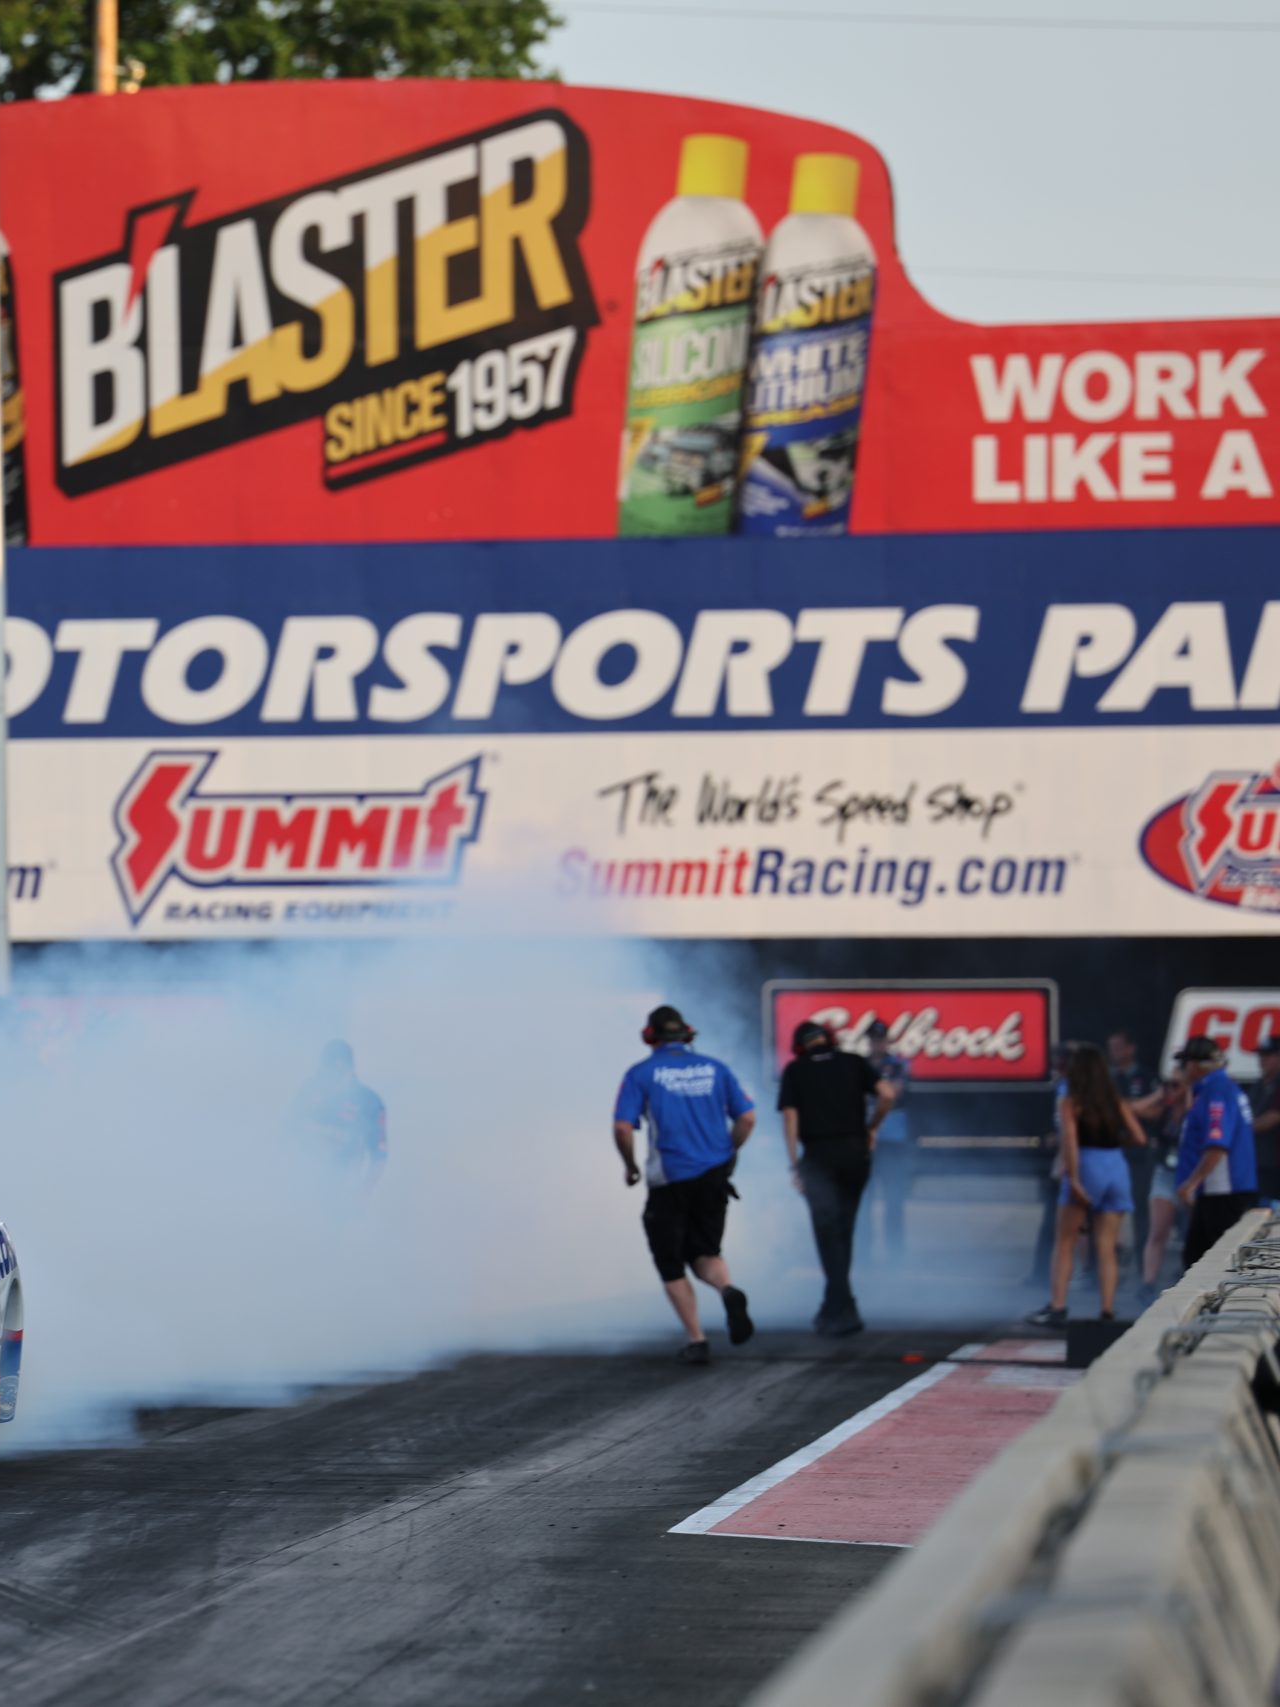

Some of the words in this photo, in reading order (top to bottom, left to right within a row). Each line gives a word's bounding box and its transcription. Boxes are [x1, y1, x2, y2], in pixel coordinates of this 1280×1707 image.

[324, 371, 448, 463] SINCE
[447, 326, 577, 438] 1957
[970, 349, 1267, 424] WORK
[972, 432, 1176, 503] LIKE
[1199, 430, 1274, 499] A
[1019, 601, 1280, 713] PA
[127, 763, 467, 896] SUMMIT
[597, 770, 680, 836] The
[696, 773, 802, 828] World's
[813, 780, 916, 844] Speed
[926, 784, 1015, 839] Shop
[164, 902, 273, 921] RACING
[557, 847, 1069, 907] SummitRacing.com
